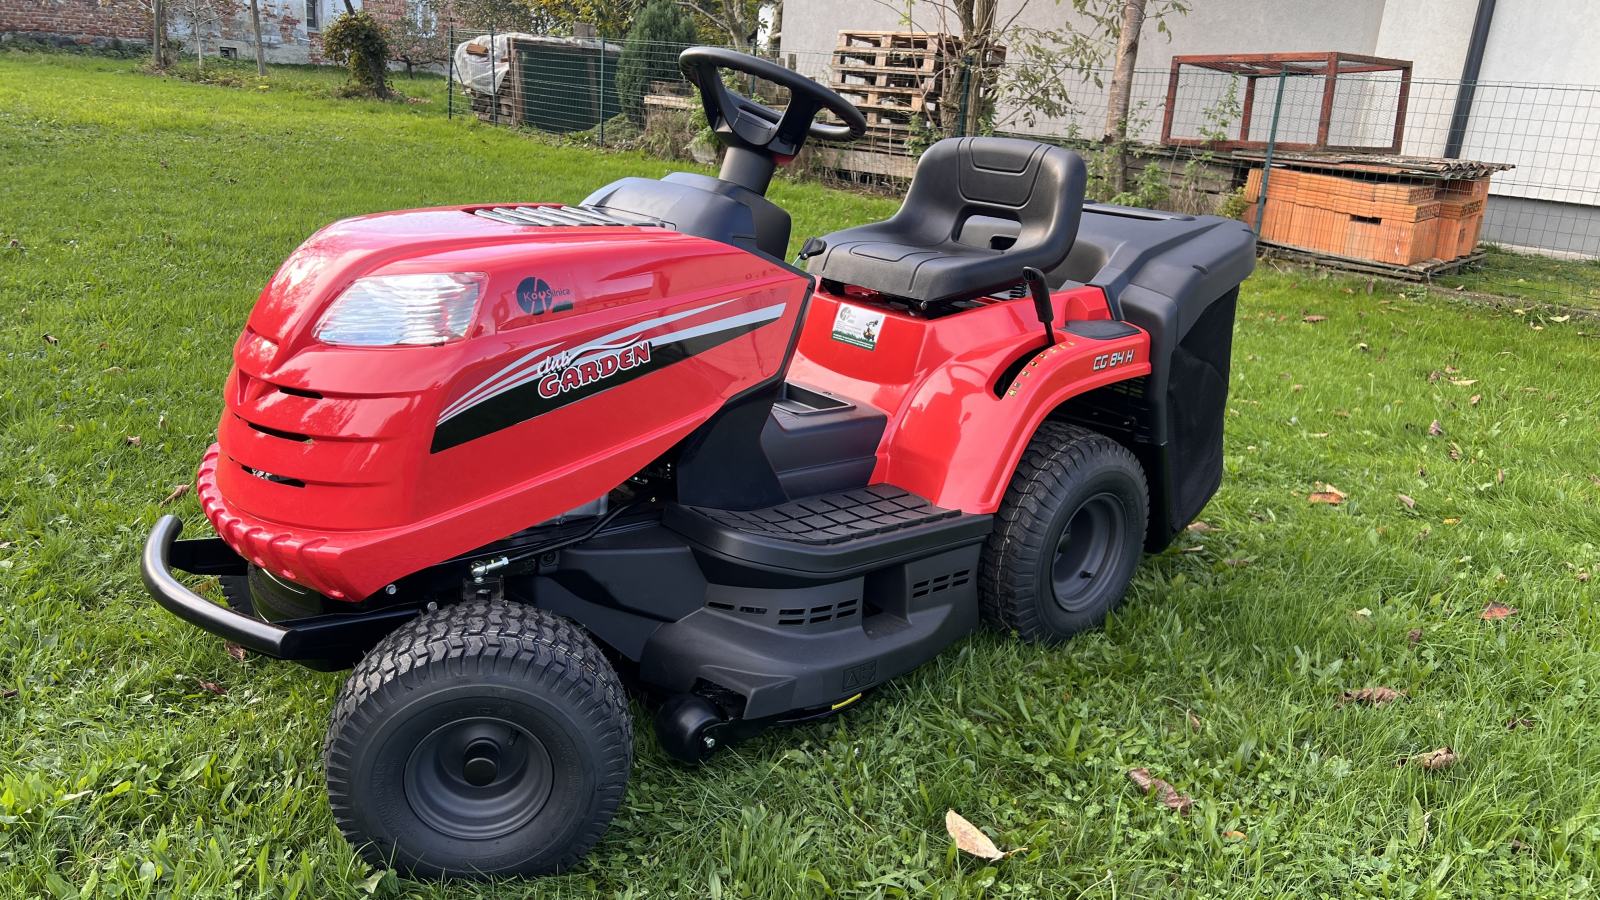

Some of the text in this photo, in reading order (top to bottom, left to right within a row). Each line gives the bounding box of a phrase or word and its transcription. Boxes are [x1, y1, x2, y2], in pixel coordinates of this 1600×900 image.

[537, 351, 571, 375] club
[538, 341, 652, 398] GARDEN
[1093, 349, 1135, 371] CG 84 H
